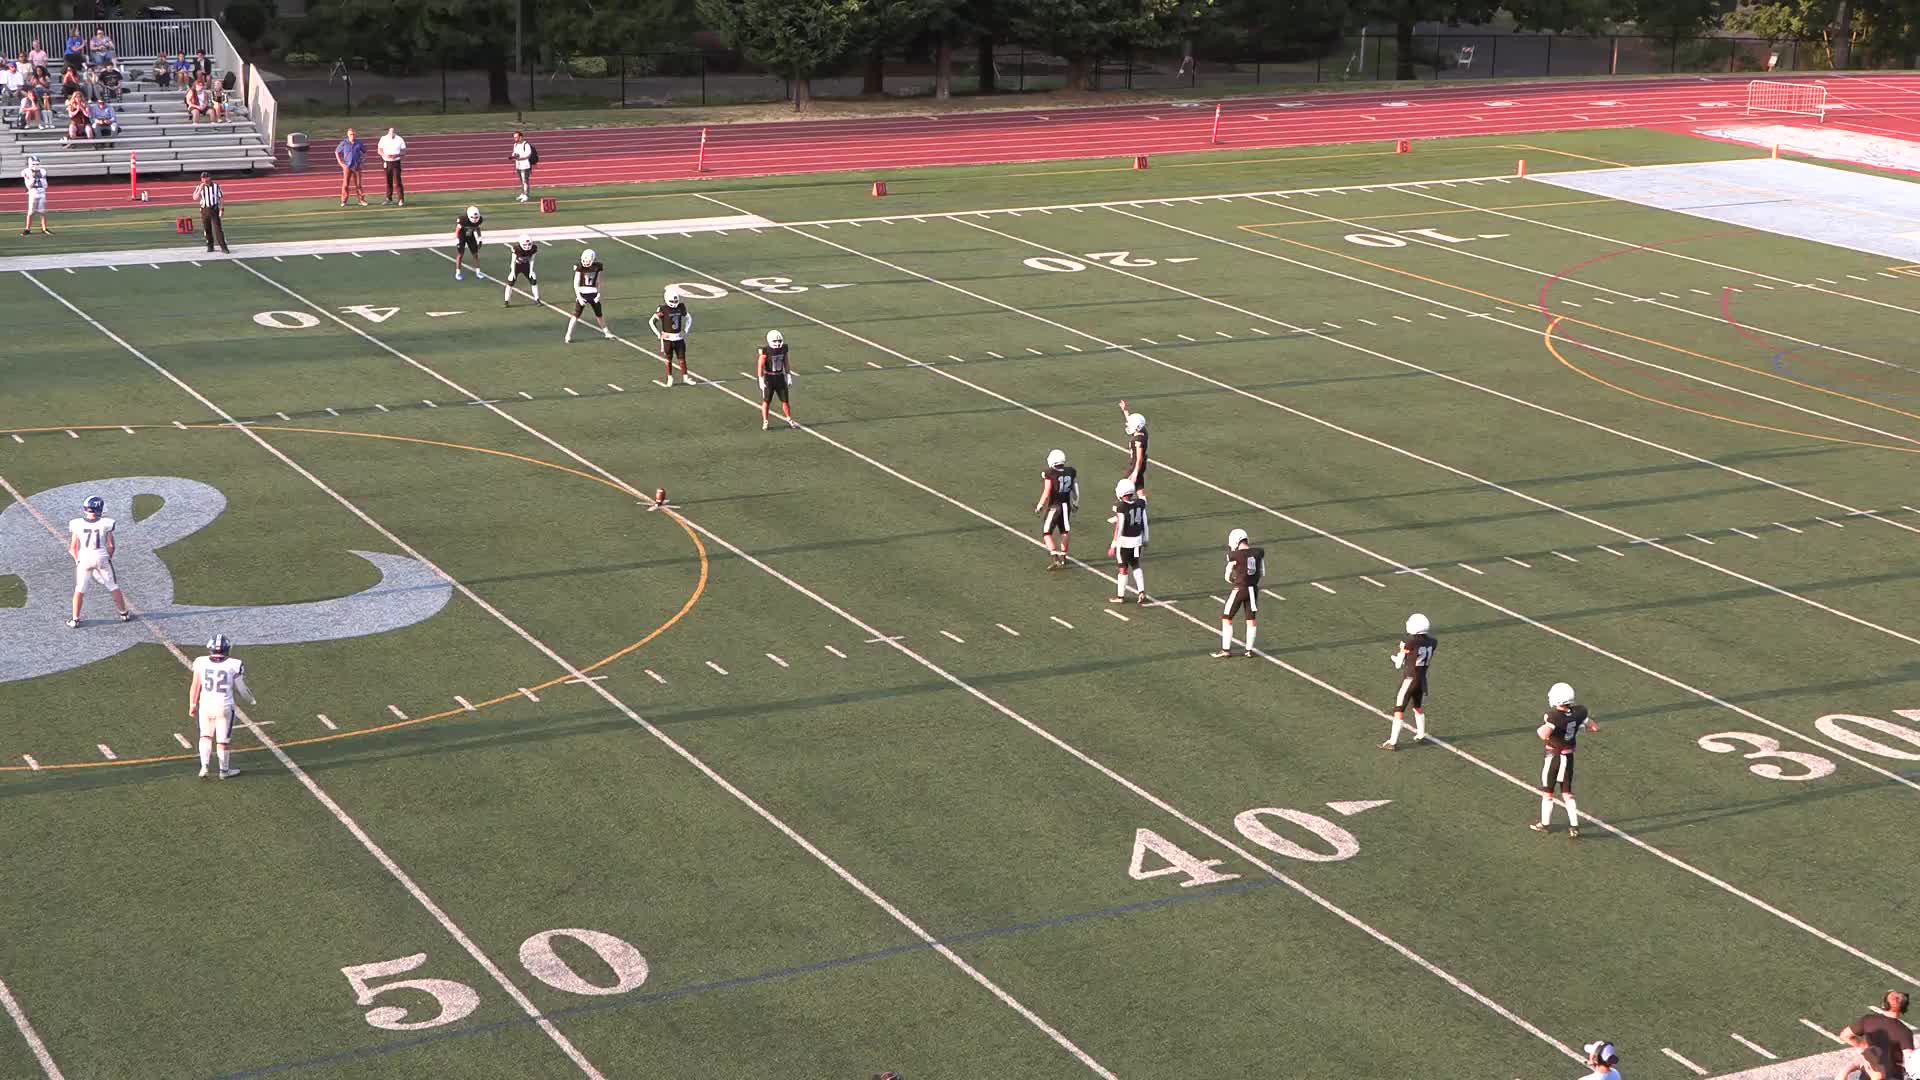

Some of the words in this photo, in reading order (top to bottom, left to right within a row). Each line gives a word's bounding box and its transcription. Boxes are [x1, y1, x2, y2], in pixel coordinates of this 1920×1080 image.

[177, 217, 193, 232] 40
[1058, 475, 1072, 493] 12
[1129, 507, 1144, 527] 14
[83, 528, 102, 550] 71
[1247, 556, 1256, 576] 9
[1415, 646, 1433, 667] 21
[205, 668, 229, 693] 52
